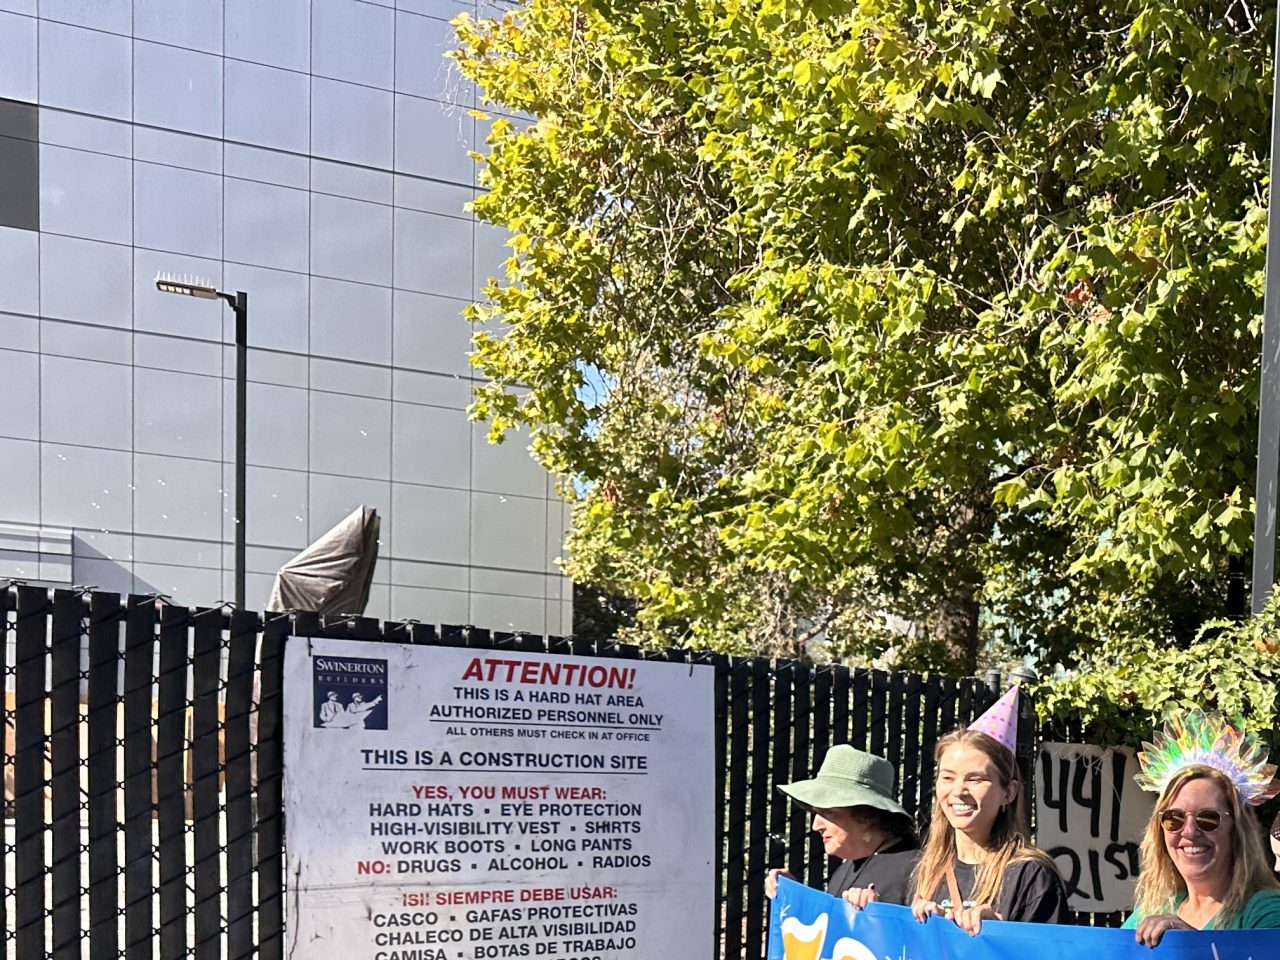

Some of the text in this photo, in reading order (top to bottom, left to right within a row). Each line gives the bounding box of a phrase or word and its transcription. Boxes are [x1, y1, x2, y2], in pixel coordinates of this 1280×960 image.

[316, 659, 384, 674] SWINERTON
[462, 658, 636, 689] ATTENTION!
[318, 676, 384, 685] BUILDERS
[453, 687, 644, 708] THIS IS A HARD HAT AREA
[429, 705, 664, 726] AUTHORIZED PERSONNEL ONLY
[446, 727, 650, 742] ALL OTHERS MUST CHECK IN AT OFFICE
[361, 750, 648, 769] THIS IS A CONSTRUCTION SITE
[412, 785, 607, 801] YES, YOU MUST WEAR:
[1041, 751, 1127, 842] 441
[369, 803, 642, 817] HARD HATS EYE PROTECTION
[370, 821, 641, 836] HIGH-VISIBILITY VEST SHIRTS
[381, 838, 632, 854] WORK BOOTS LONG PANTS
[357, 855, 651, 875] NO: DRUGS ALCOHOL RADIOS
[436, 890, 514, 905] SIEMPRE
[520, 888, 565, 902] DEBE
[570, 886, 618, 900] USAR:
[373, 903, 638, 928] CASCO GAFAS PROTECTIVAS
[375, 920, 636, 946] CHALECO DE ALTA VISIBILIDAD
[474, 943, 530, 959] BOTAS
[535, 942, 557, 955] DE
[563, 937, 636, 953] TRABAJO
